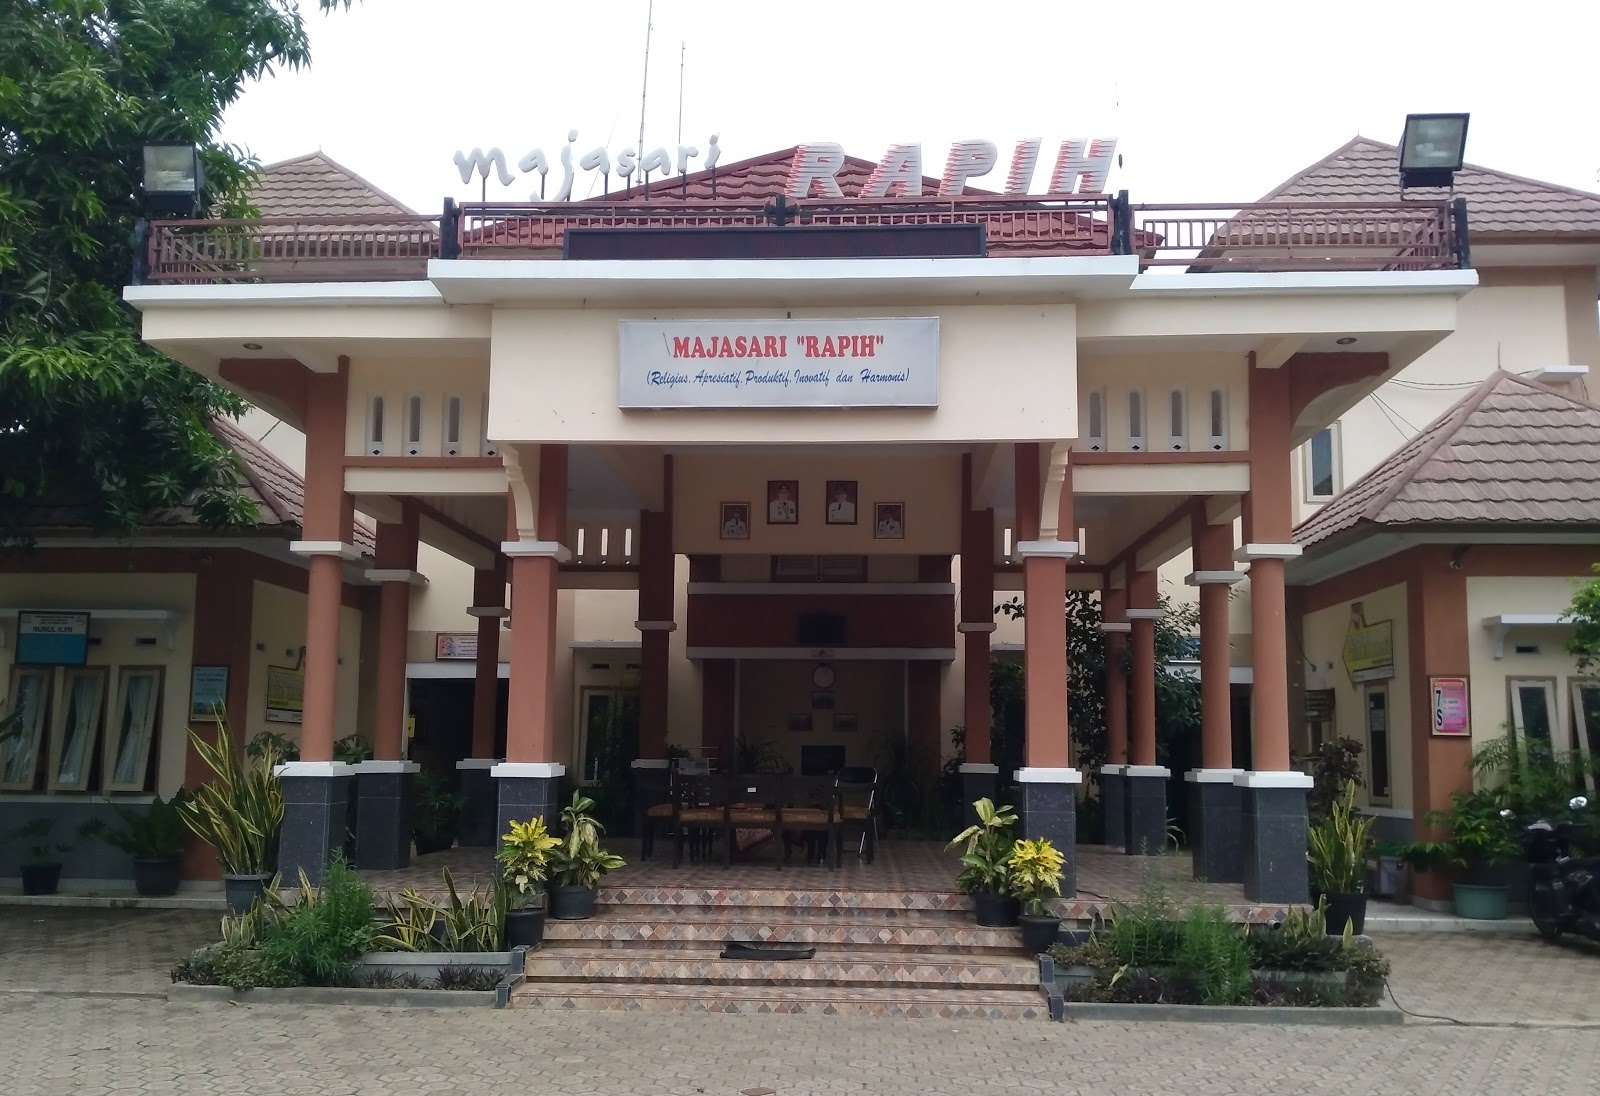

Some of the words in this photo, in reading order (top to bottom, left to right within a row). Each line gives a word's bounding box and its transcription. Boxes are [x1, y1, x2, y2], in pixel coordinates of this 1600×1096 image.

[453, 129, 721, 203] majasari
[783, 136, 1119, 199] RAPIH
[673, 335, 788, 358] MAJASARI
[796, 334, 884, 358] "RAPIH"
[794, 368, 831, 387] Inovatif
[835, 370, 854, 383] dan
[860, 367, 910, 384] Harmonis)
